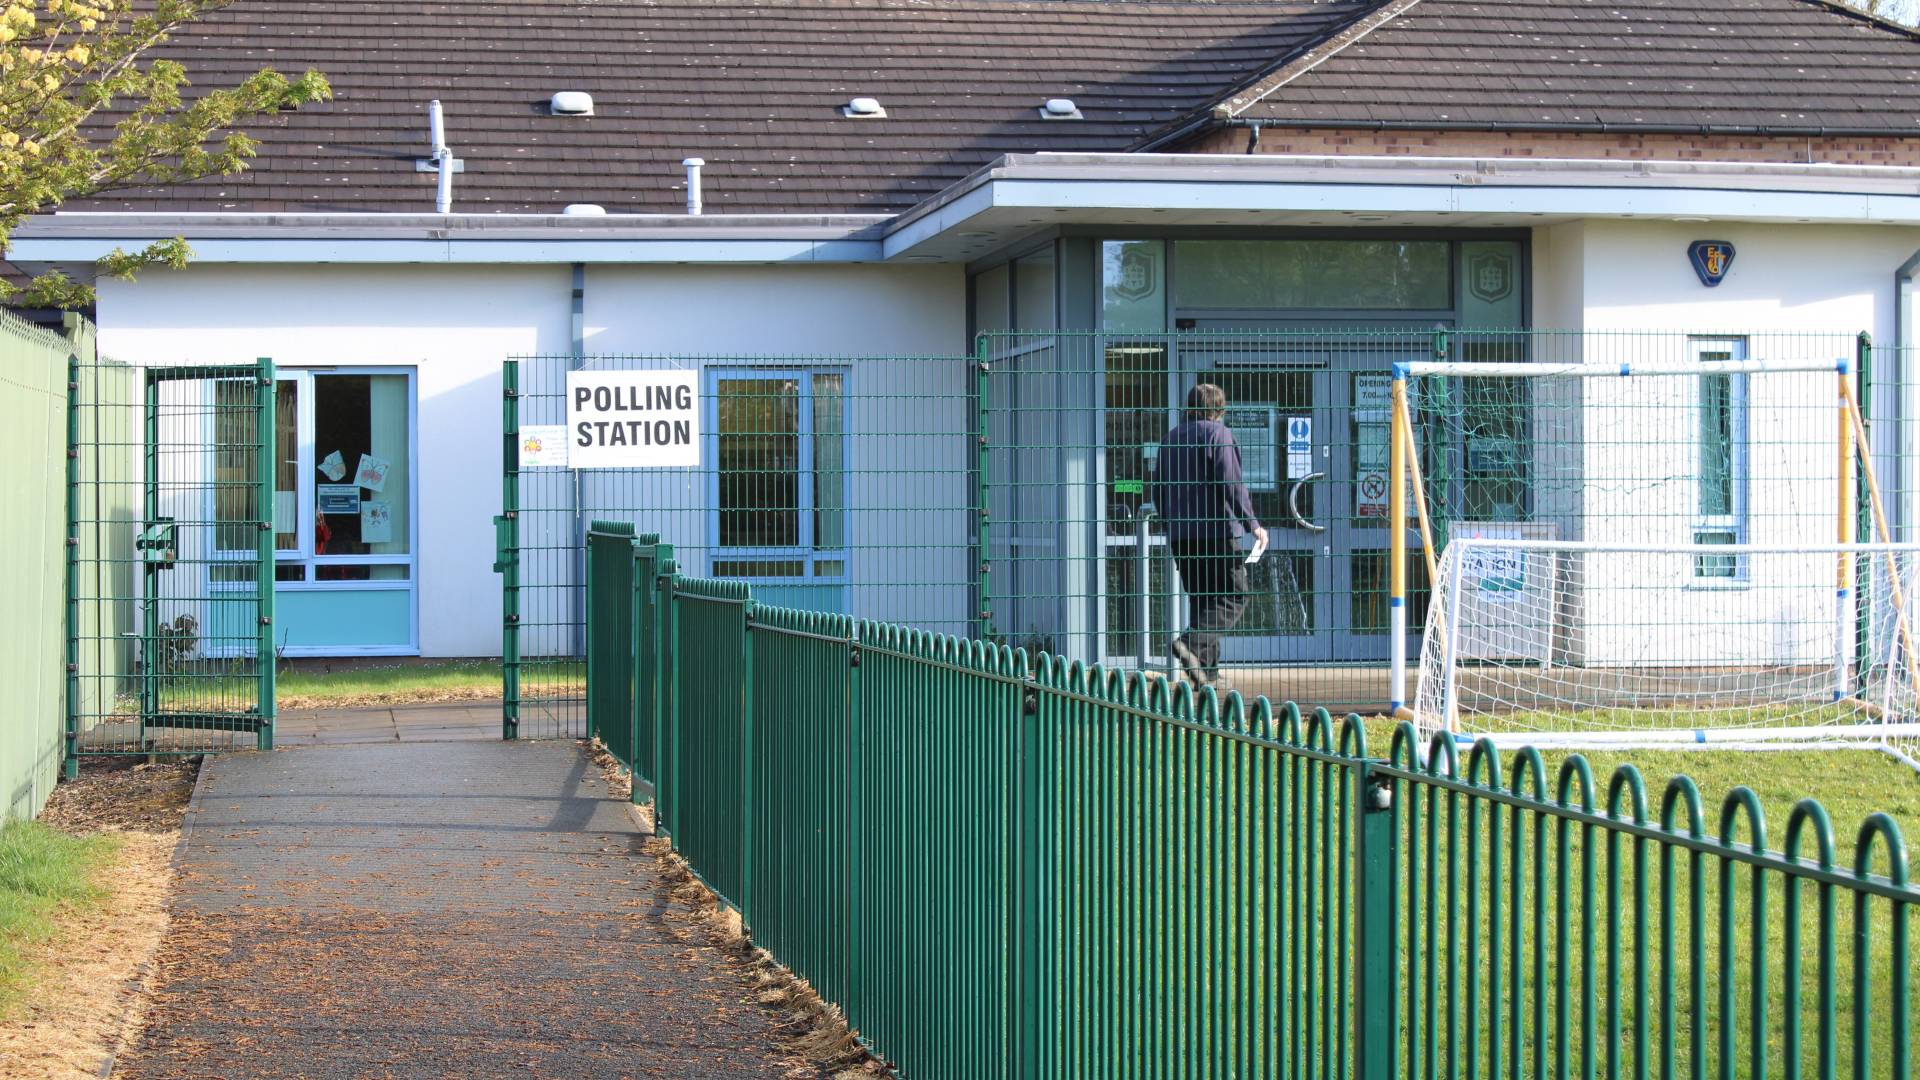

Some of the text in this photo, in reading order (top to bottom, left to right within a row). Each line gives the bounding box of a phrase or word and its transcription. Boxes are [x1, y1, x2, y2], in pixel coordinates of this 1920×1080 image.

[1359, 379, 1391, 388] OPENING
[575, 385, 691, 412] POLLING
[577, 420, 690, 447] STATION
